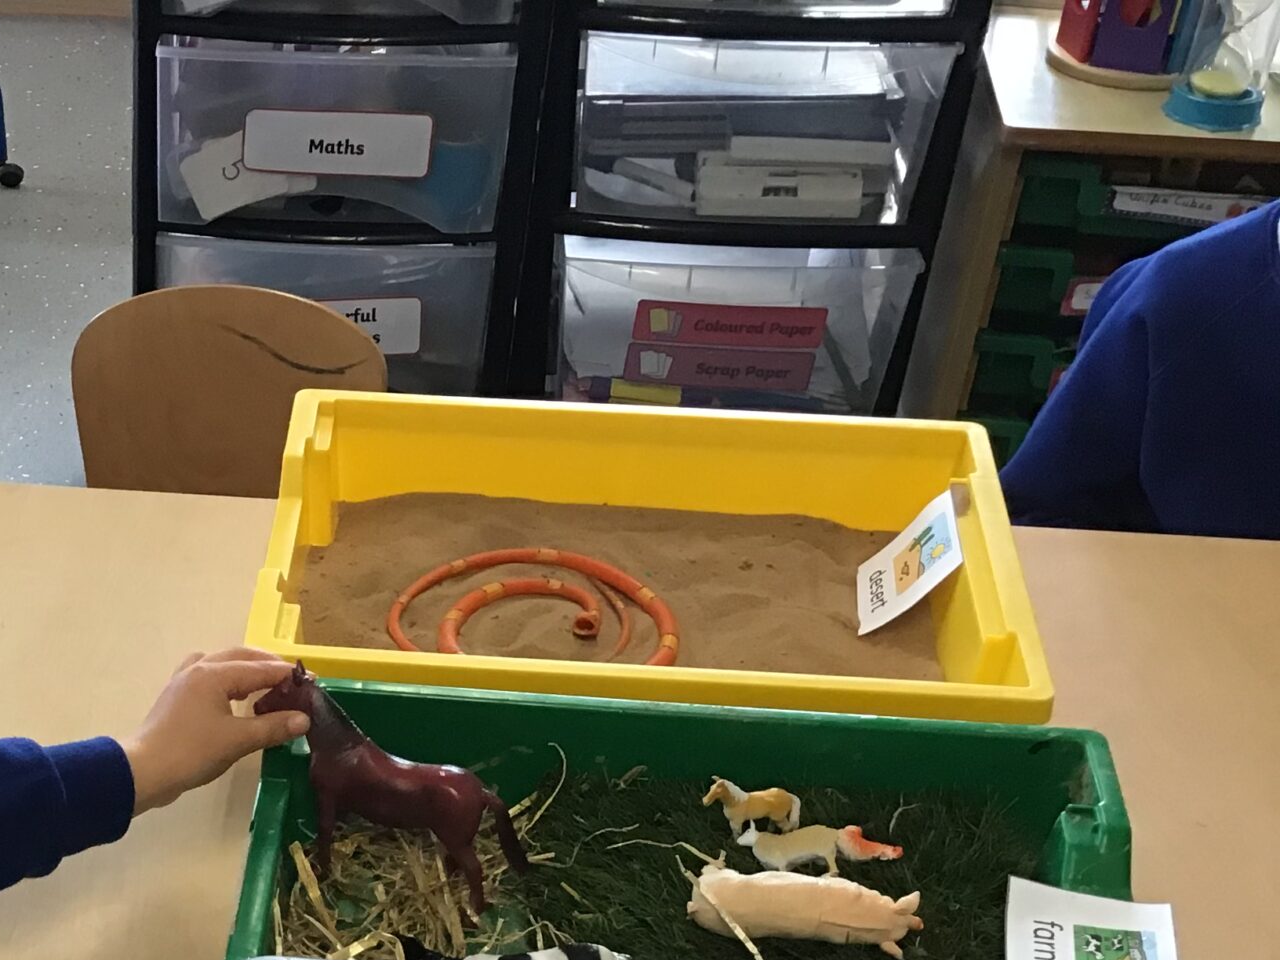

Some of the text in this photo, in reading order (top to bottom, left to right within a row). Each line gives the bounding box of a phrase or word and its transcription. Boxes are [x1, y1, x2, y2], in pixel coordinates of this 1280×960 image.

[308, 138, 365, 156] Maths
[694, 319, 817, 338] Coloured Paper
[695, 362, 792, 381] Scrap Paper
[869, 569, 888, 613] desert
